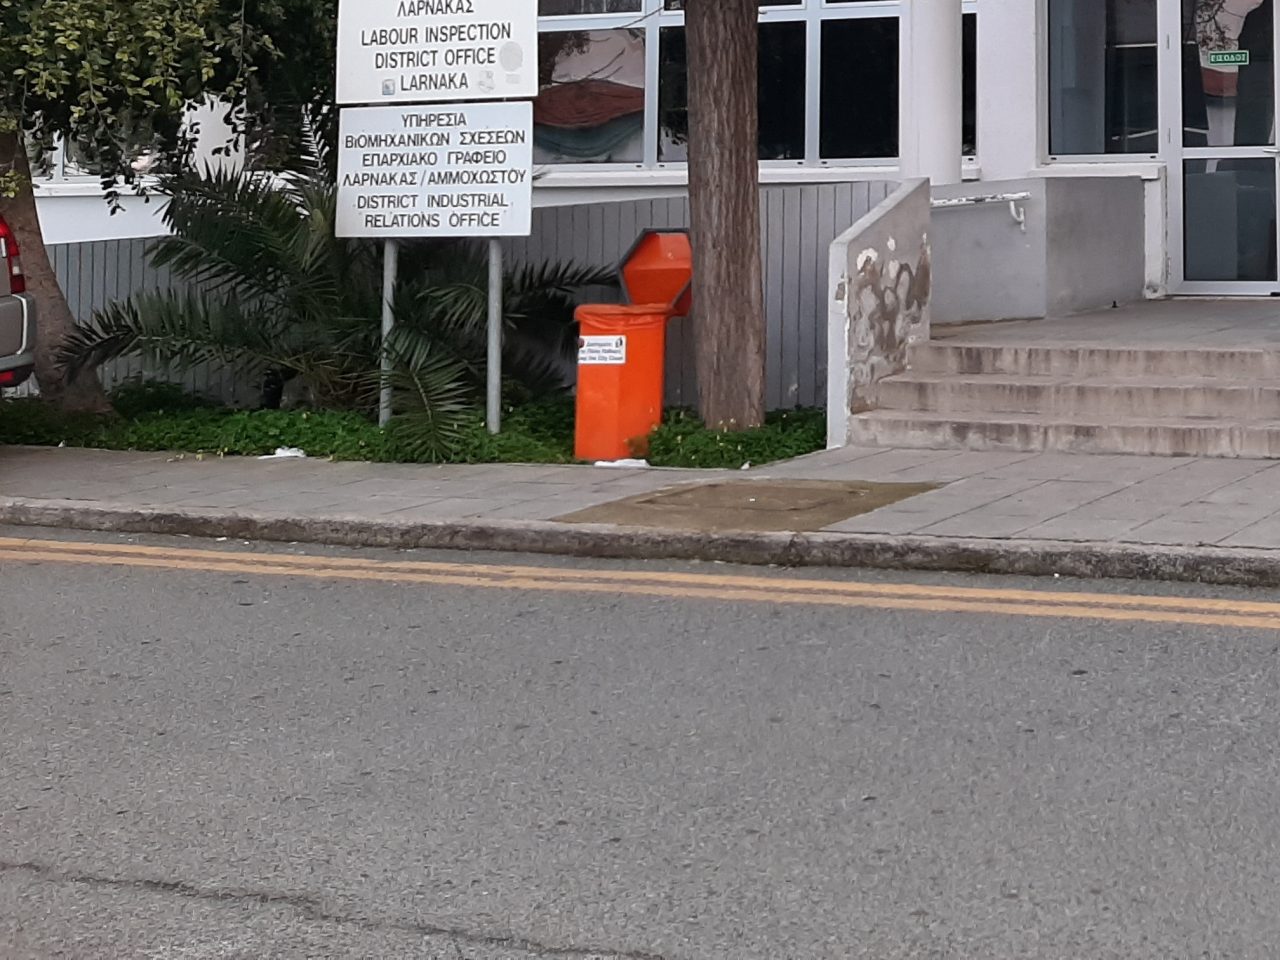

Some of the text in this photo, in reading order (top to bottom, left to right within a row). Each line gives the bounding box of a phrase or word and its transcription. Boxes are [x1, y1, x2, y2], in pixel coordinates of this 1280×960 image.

[361, 22, 511, 46] LABOUR INSPECTION
[375, 47, 496, 69] DISTRICT OFFICE
[400, 73, 469, 91] LARNAKA
[401, 112, 467, 128] ΥΠΗΡΕΣΙΑ
[345, 130, 525, 149] ΒΙΟΜΗΧΑΝΙΚΩΝ ΣΧΕΣΕΩΝ
[362, 150, 507, 167] ΕΠΑΡΧΙΑΚΟ ΓΡΑΦΕΙΟ
[357, 193, 509, 209] DISTRICT INDUSTRIAL
[365, 212, 500, 228] RELATIONS OFFICE
